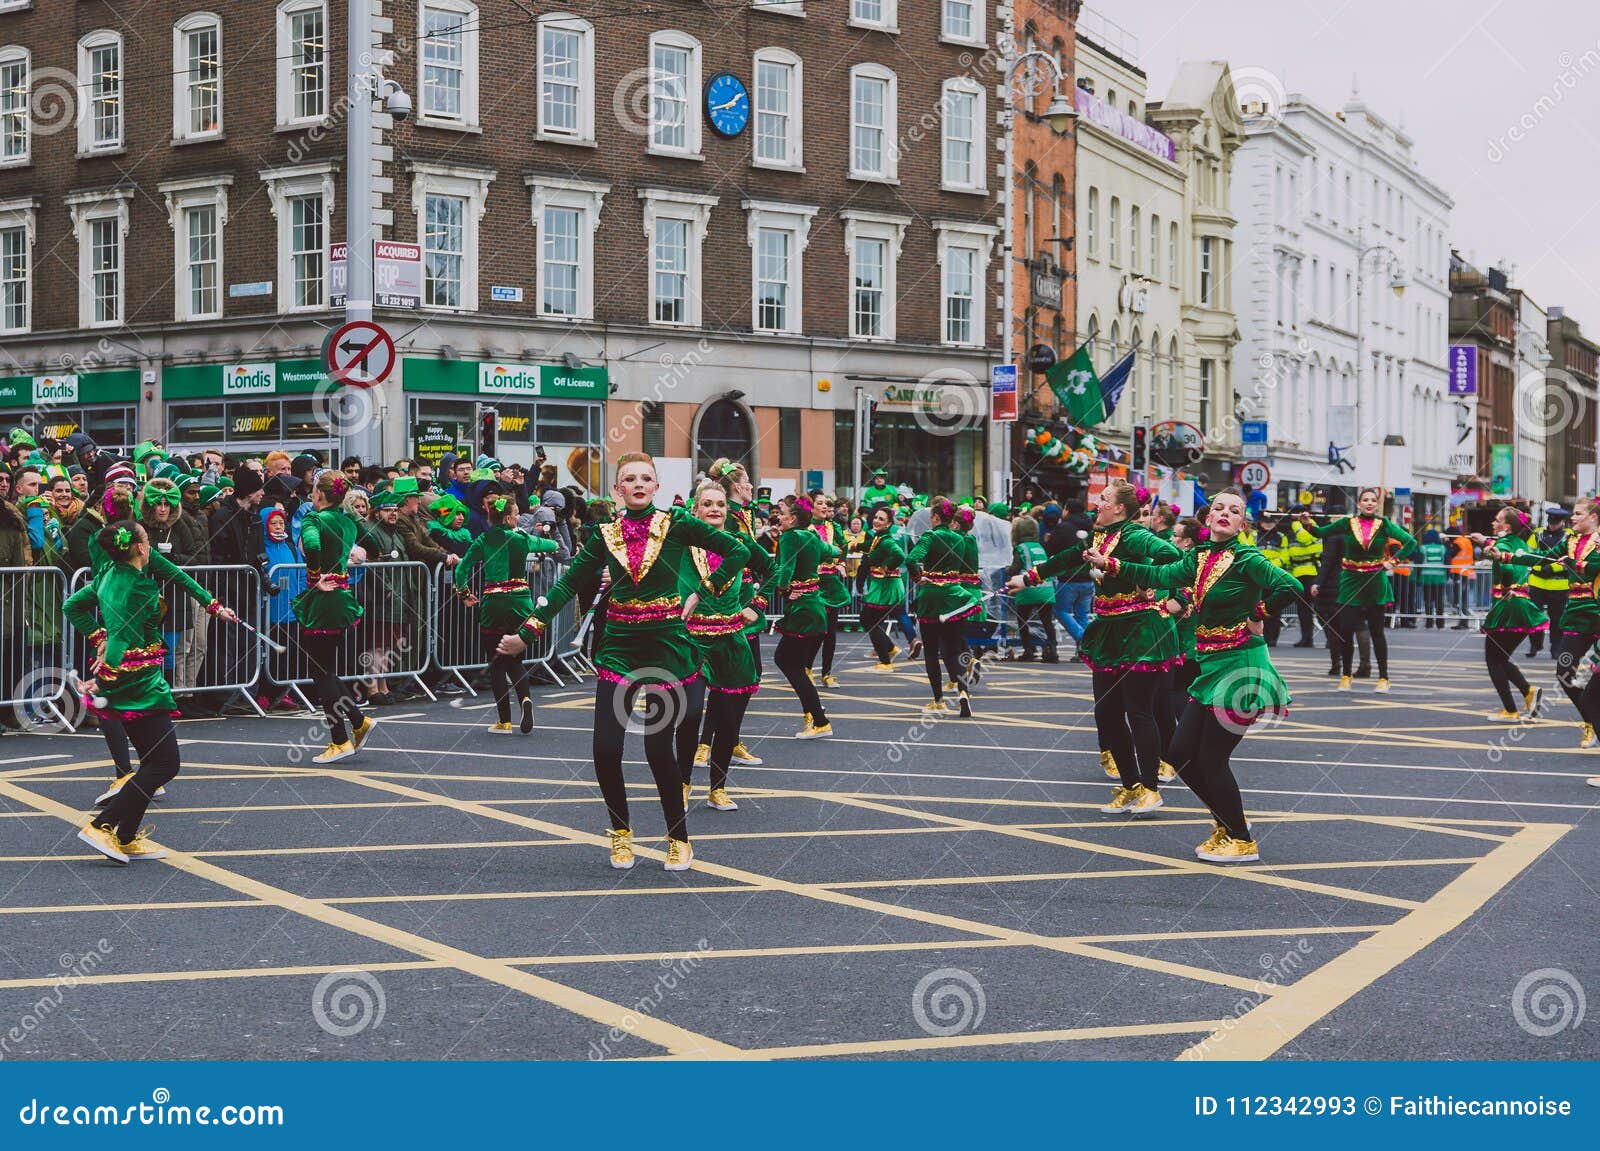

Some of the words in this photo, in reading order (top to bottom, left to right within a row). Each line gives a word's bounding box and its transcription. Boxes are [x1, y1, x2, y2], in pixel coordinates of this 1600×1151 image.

[377, 245, 419, 260] ACQUIRED
[389, 297, 401, 306] 232
[227, 371, 271, 389] Londis
[282, 371, 328, 382] Westmorelan
[484, 371, 536, 390] Londis
[553, 377, 567, 386] Off
[567, 377, 595, 388] Licence
[36, 381, 74, 399] Londis
[41, 424, 79, 439] SUBWAY
[233, 416, 275, 433] SUBWAY
[427, 426, 443, 434] Happy
[498, 417, 530, 432] WAY
[1183, 434, 1197, 444] 30
[1246, 468, 1263, 481] 30
